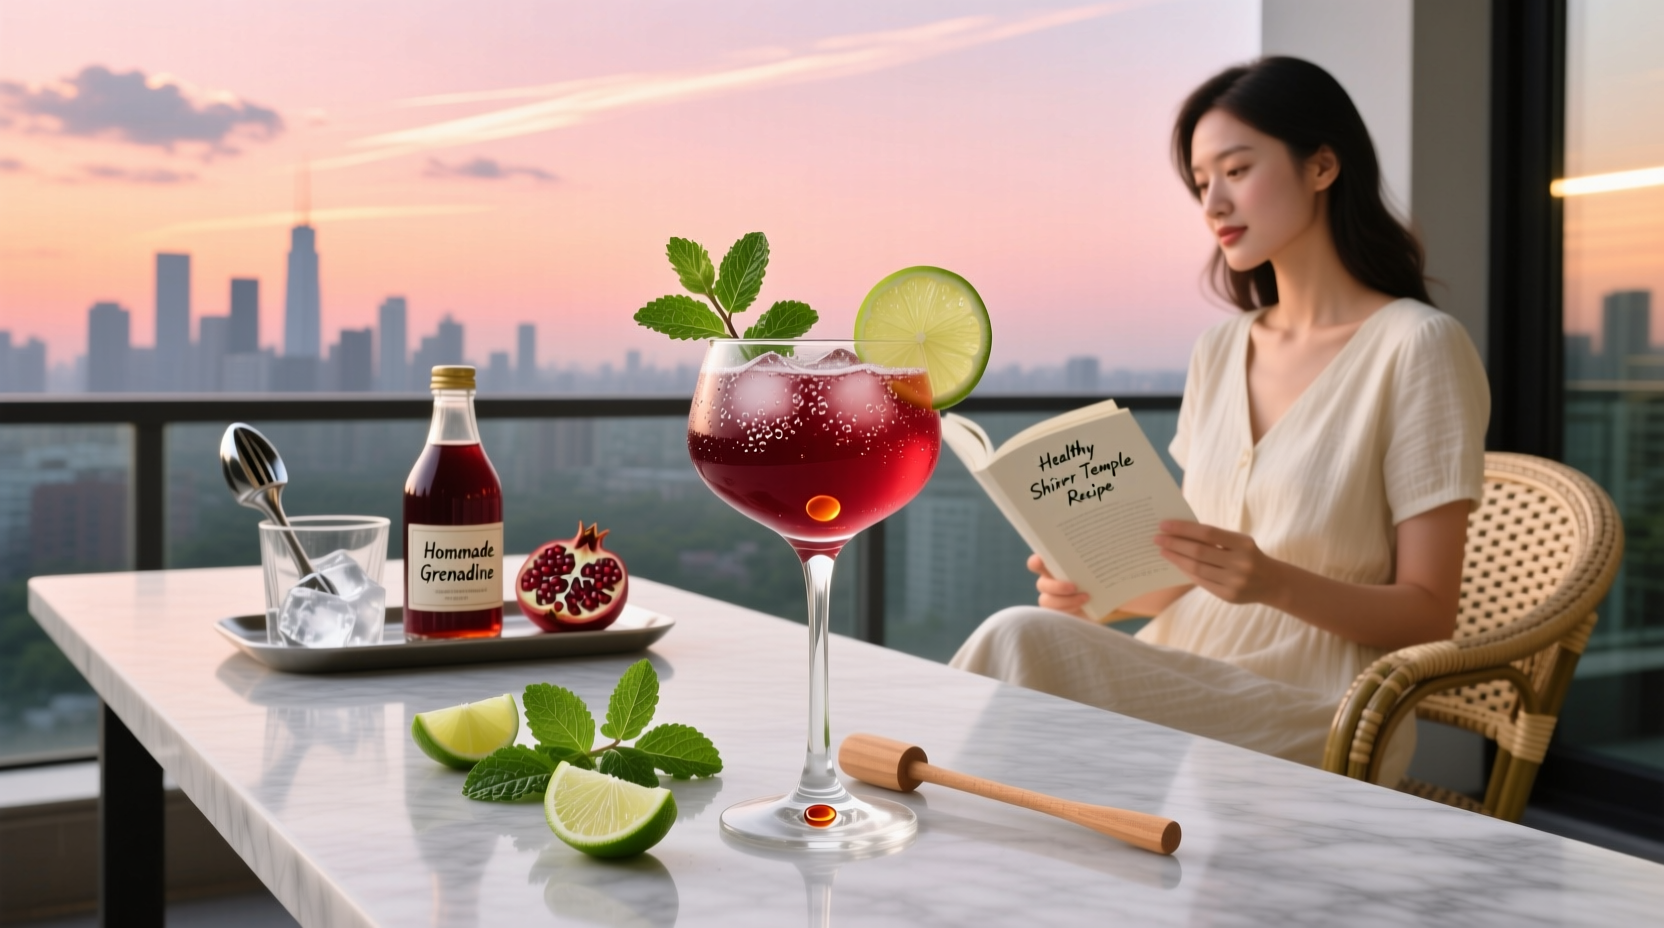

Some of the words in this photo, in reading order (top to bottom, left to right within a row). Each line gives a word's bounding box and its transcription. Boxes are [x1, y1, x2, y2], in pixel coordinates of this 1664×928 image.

[1039, 440, 1094, 471] Healthy
[1079, 452, 1134, 477] Temple
[424, 540, 495, 559] Hommade
